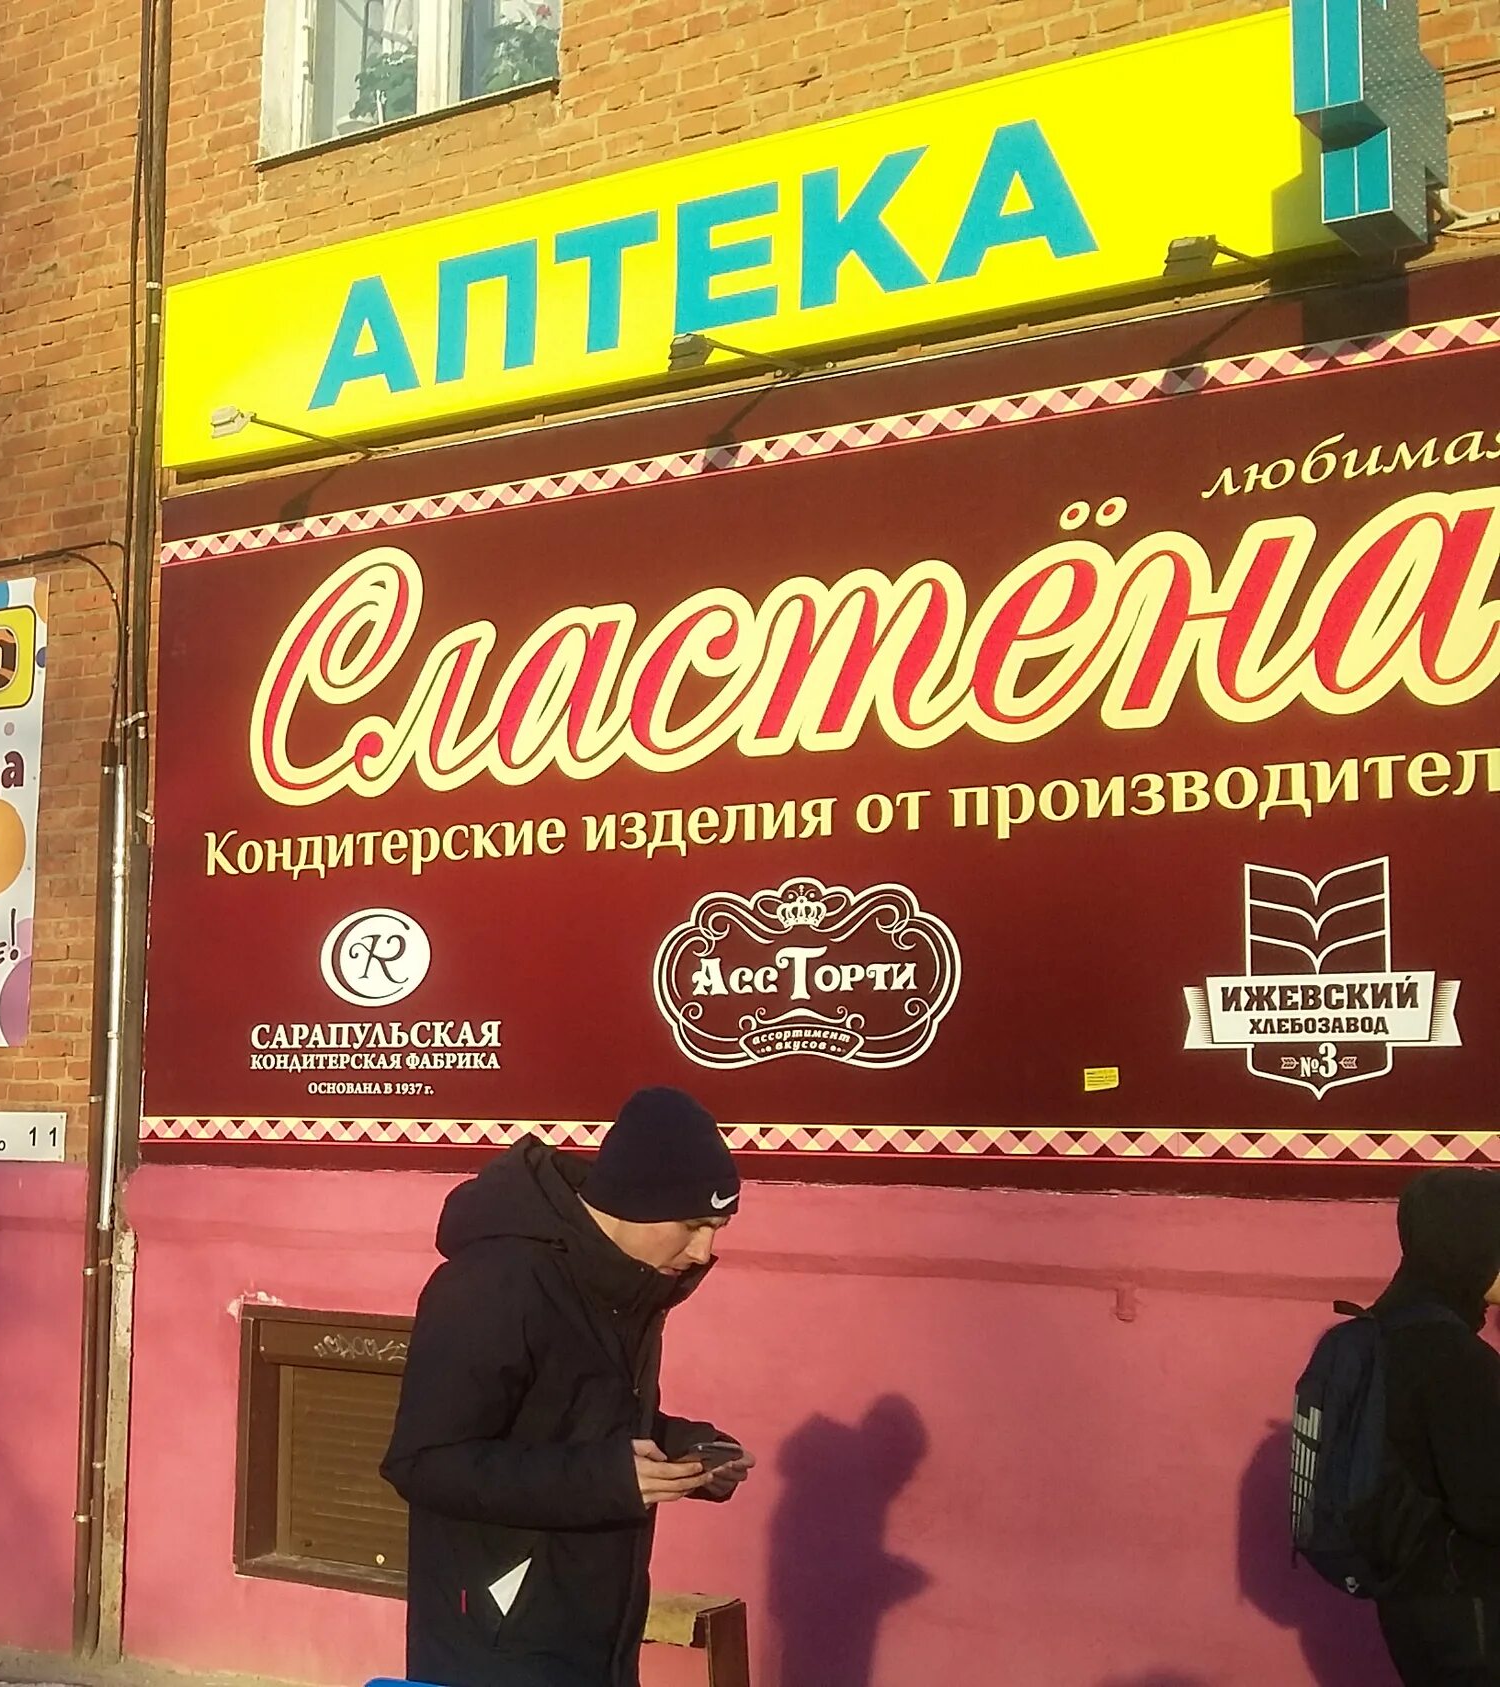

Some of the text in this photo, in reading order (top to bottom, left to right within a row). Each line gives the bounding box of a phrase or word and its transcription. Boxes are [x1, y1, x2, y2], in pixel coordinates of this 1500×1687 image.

[308, 119, 1098, 410] АПТЕКА
[248, 485, 1500, 804] Сластёна
[204, 810, 566, 880] Кондитерские
[583, 797, 836, 858] изделия
[856, 788, 931, 831] от
[1220, 975, 1419, 1012] ИЖЕВСКИЙ
[251, 1021, 502, 1050] САРАПУЛЬСКАЯ
[752, 1029, 851, 1046] ассортимент
[1248, 1016, 1389, 1034] ХЛЕБОЗАВОД
[775, 1041, 827, 1051] вкусов
[250, 1052, 501, 1073] КОНДИТЕРСКАЯ ФАБРИКА
[308, 1082, 435, 1095] ОСНОВАНА В 1937 г.
